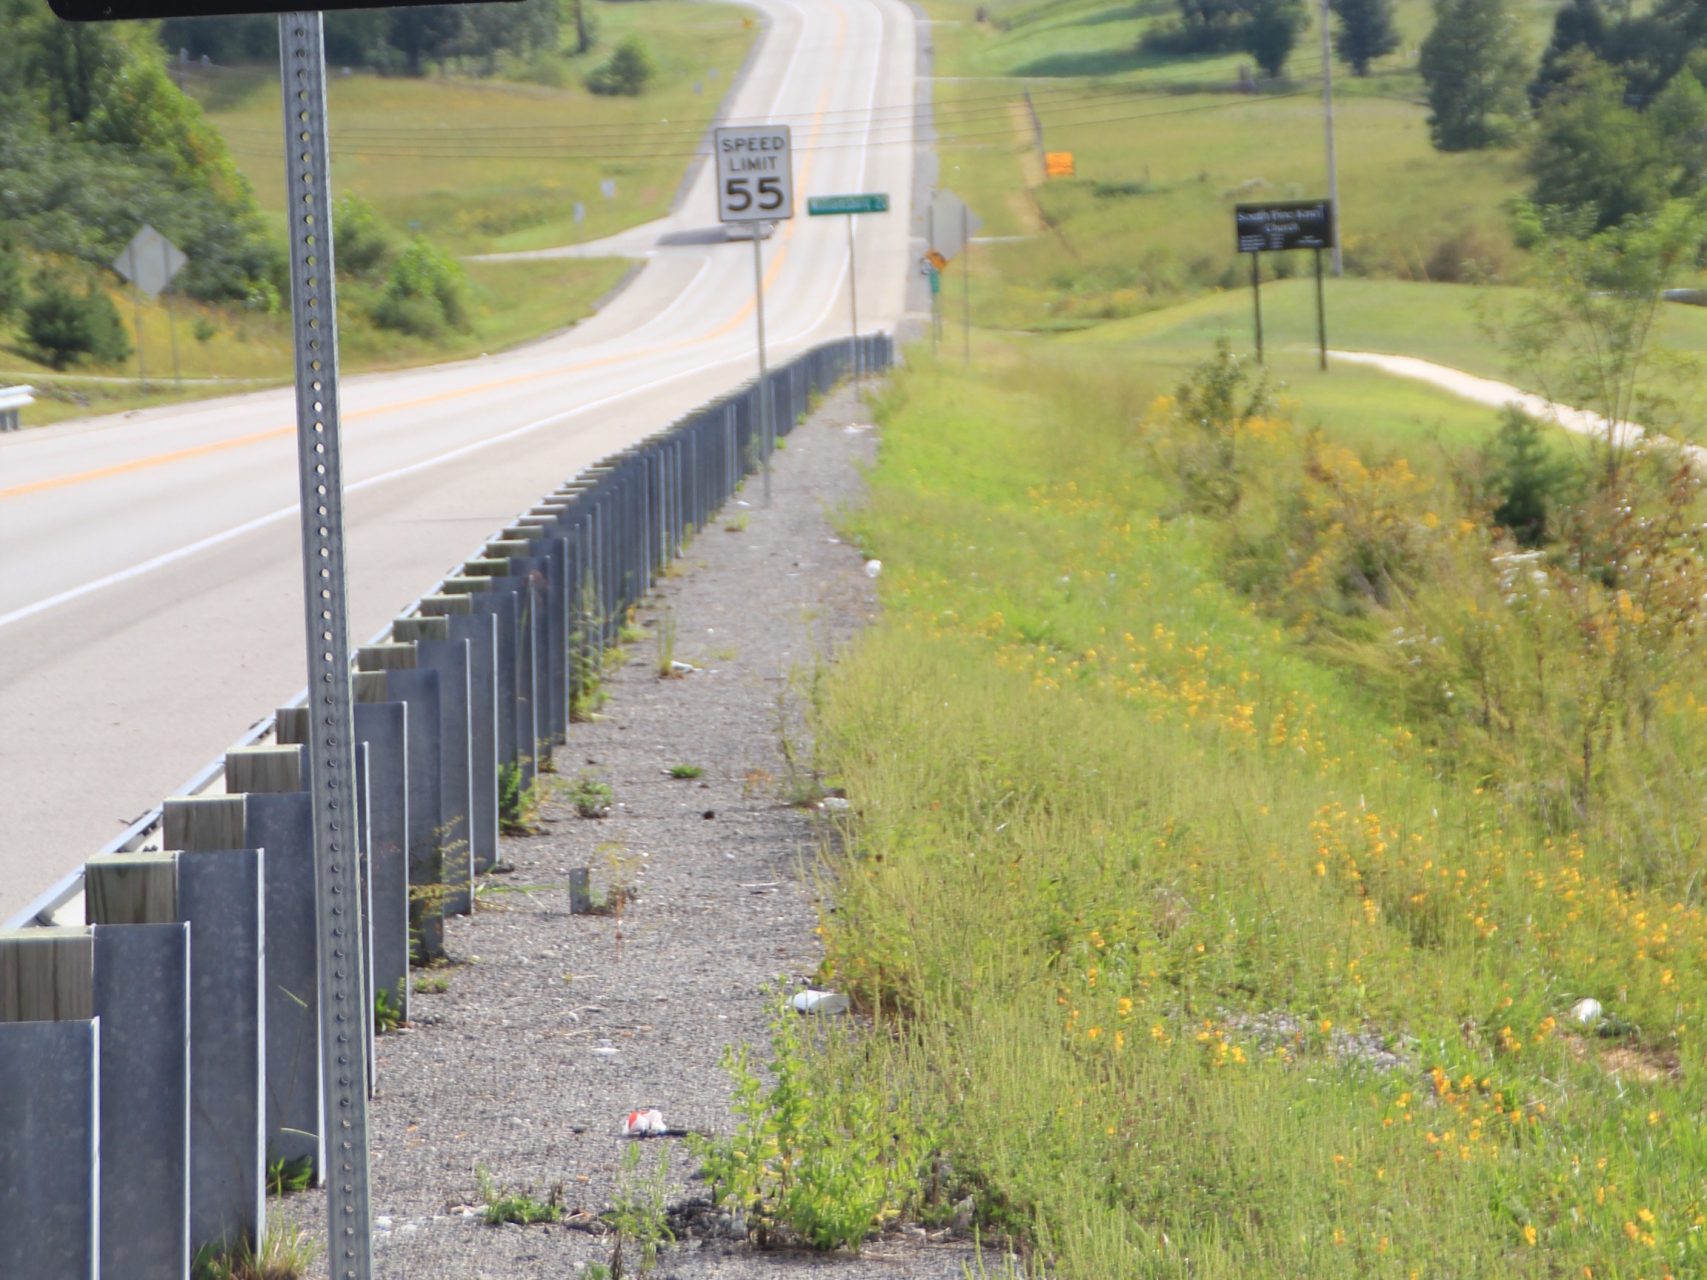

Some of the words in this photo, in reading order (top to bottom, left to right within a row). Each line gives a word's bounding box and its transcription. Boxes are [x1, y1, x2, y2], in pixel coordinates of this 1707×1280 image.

[721, 135, 785, 152] SPEED
[729, 155, 777, 172] LIMIT
[725, 176, 785, 213] 55
